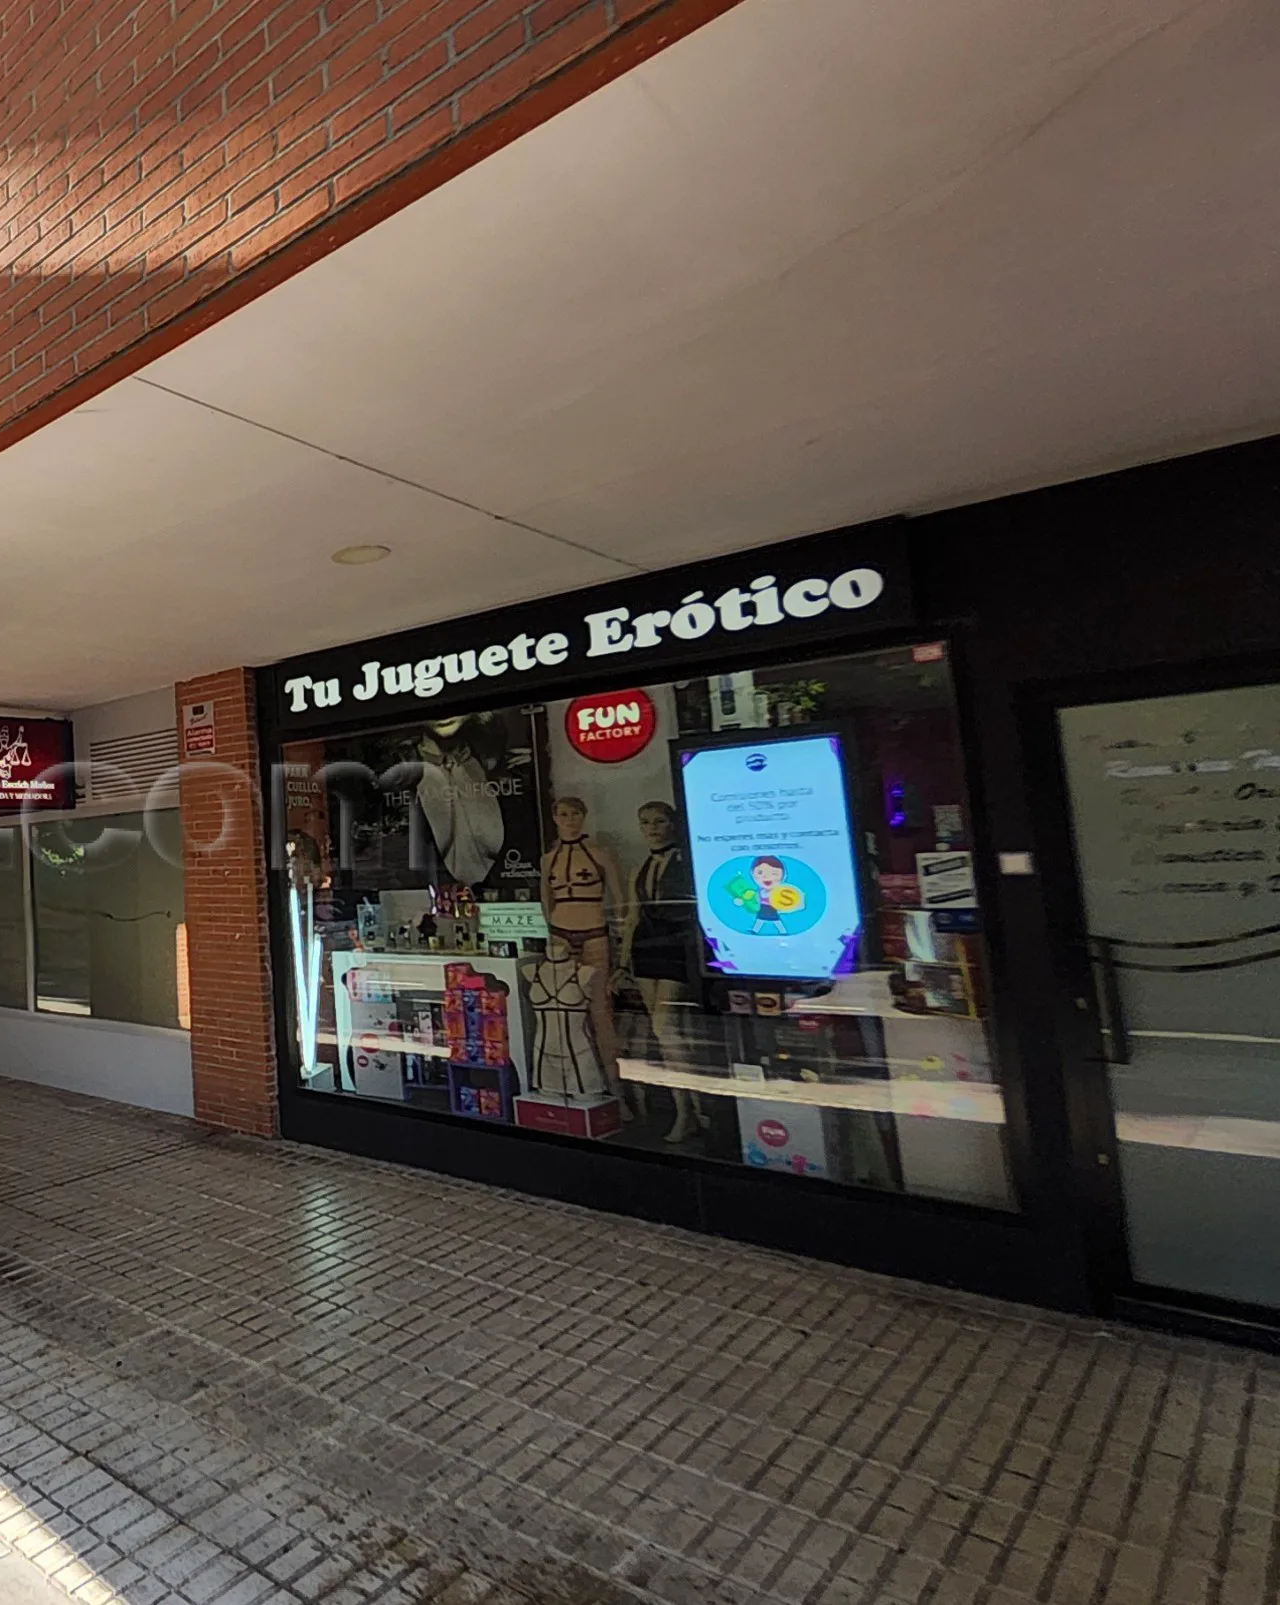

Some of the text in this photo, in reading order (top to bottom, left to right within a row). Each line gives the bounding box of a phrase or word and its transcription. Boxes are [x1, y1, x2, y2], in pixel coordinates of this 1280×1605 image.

[284, 568, 884, 712] Tu Juguete Erótico
[577, 701, 640, 731] FUN
[580, 725, 642, 742] FACTORY
[383, 790, 411, 806] THE
[492, 915, 533, 926] MAZE
